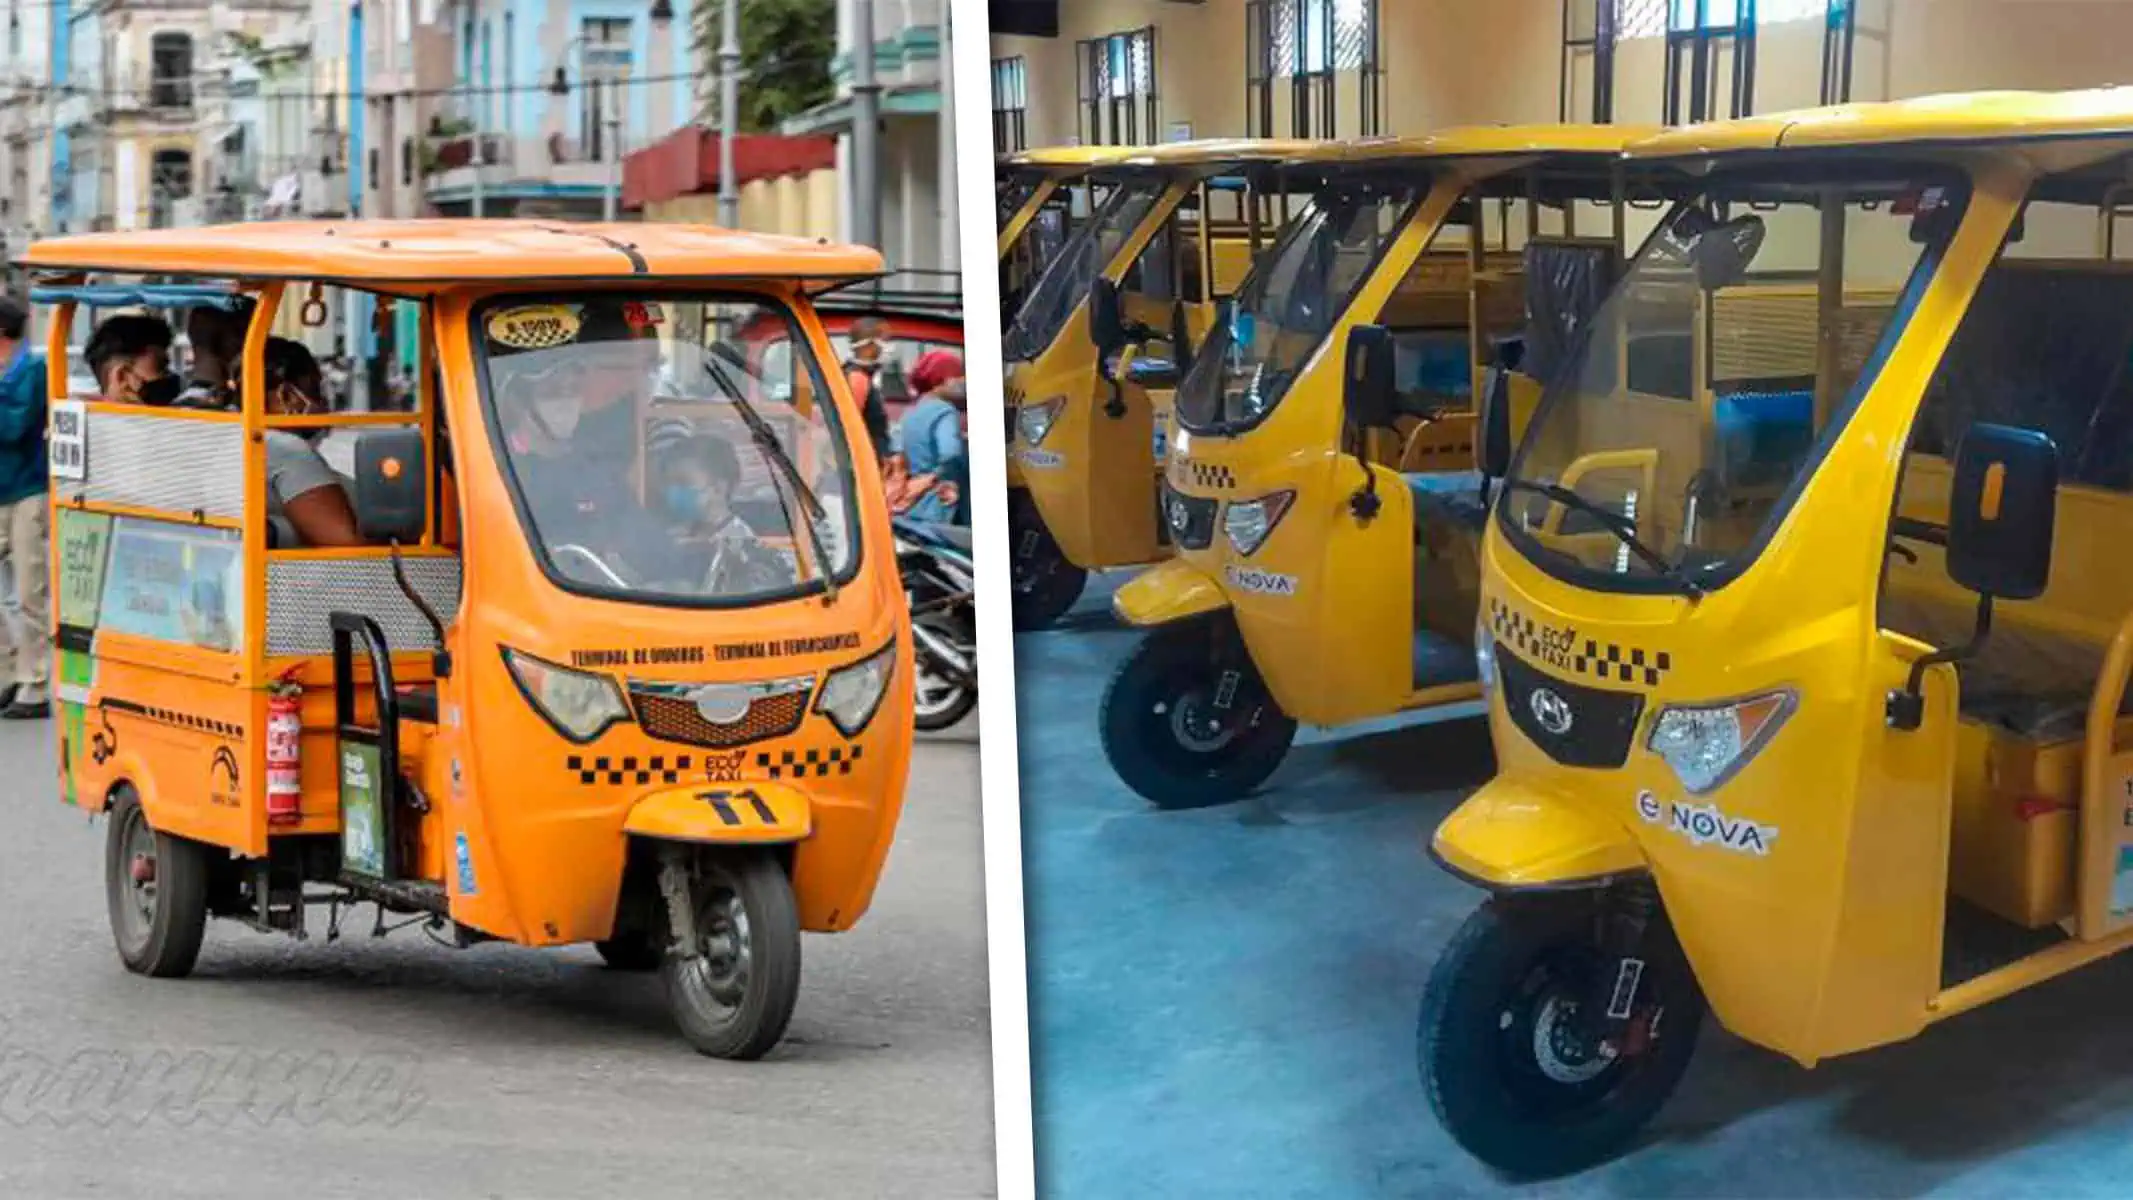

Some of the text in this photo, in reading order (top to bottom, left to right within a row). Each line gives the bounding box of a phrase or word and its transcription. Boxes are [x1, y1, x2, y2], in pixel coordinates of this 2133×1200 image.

[1238, 570, 1291, 593] NOVA
[1543, 625, 1573, 652] ECO
[1541, 647, 1571, 671] TAXI
[705, 755, 742, 770] ECO
[705, 770, 742, 783] TAXI
[693, 788, 779, 825] T1
[1670, 803, 1763, 850] NOVA
